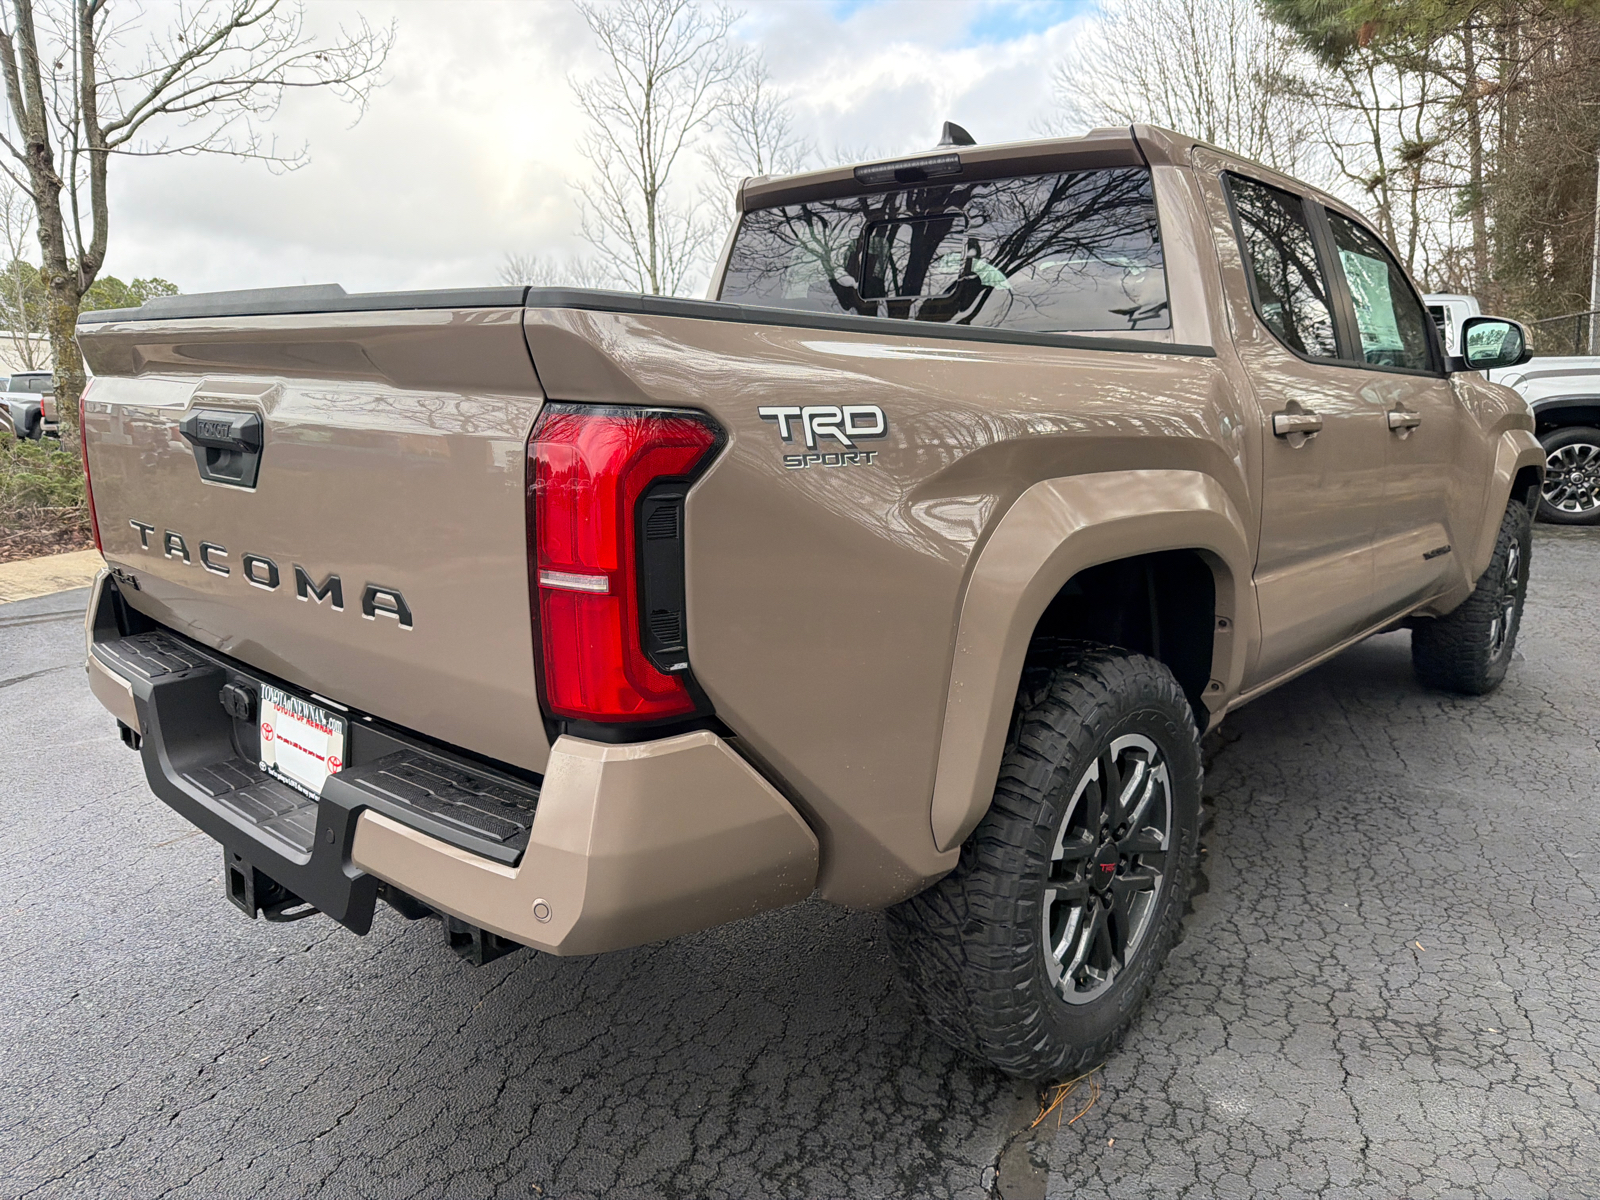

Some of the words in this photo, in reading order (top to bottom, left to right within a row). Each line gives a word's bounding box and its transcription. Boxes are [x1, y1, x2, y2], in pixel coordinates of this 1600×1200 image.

[198, 421, 232, 439] TOYOTA
[757, 404, 888, 451] TRD
[783, 450, 878, 469] SPORT
[129, 518, 414, 631] TACOMA
